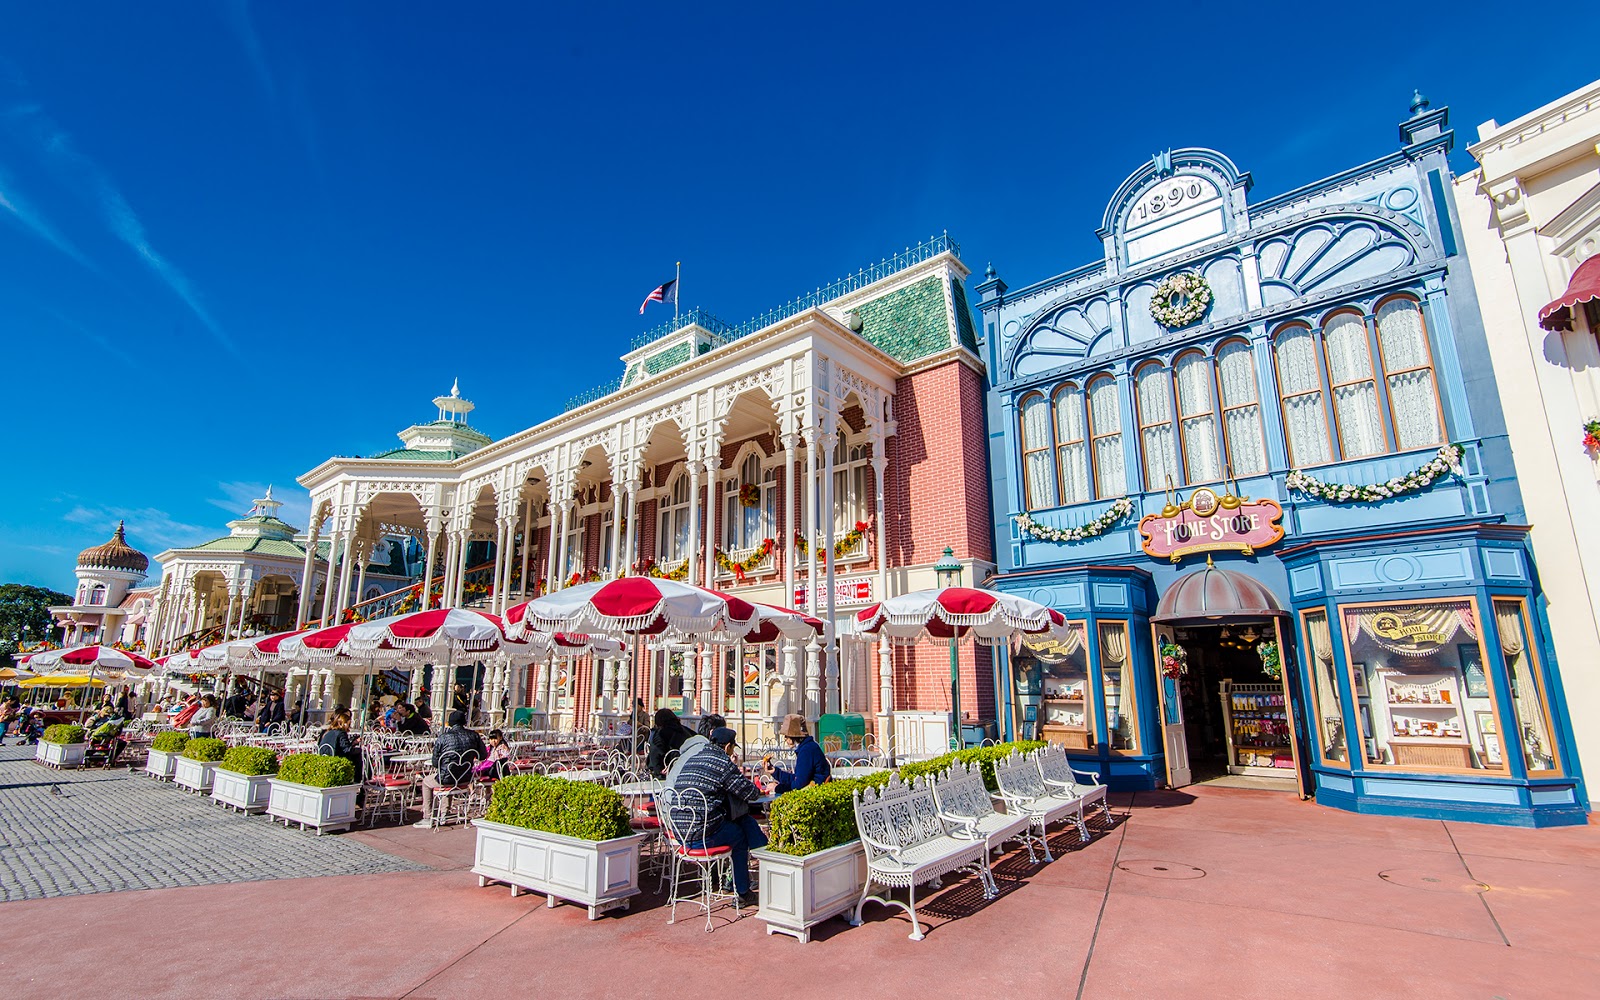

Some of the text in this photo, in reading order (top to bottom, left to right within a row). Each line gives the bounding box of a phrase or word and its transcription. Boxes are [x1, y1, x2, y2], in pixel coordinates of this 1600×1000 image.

[1138, 182, 1202, 219] 1890
[1164, 519, 1208, 546] HOME
[1210, 513, 1261, 540] STORE
